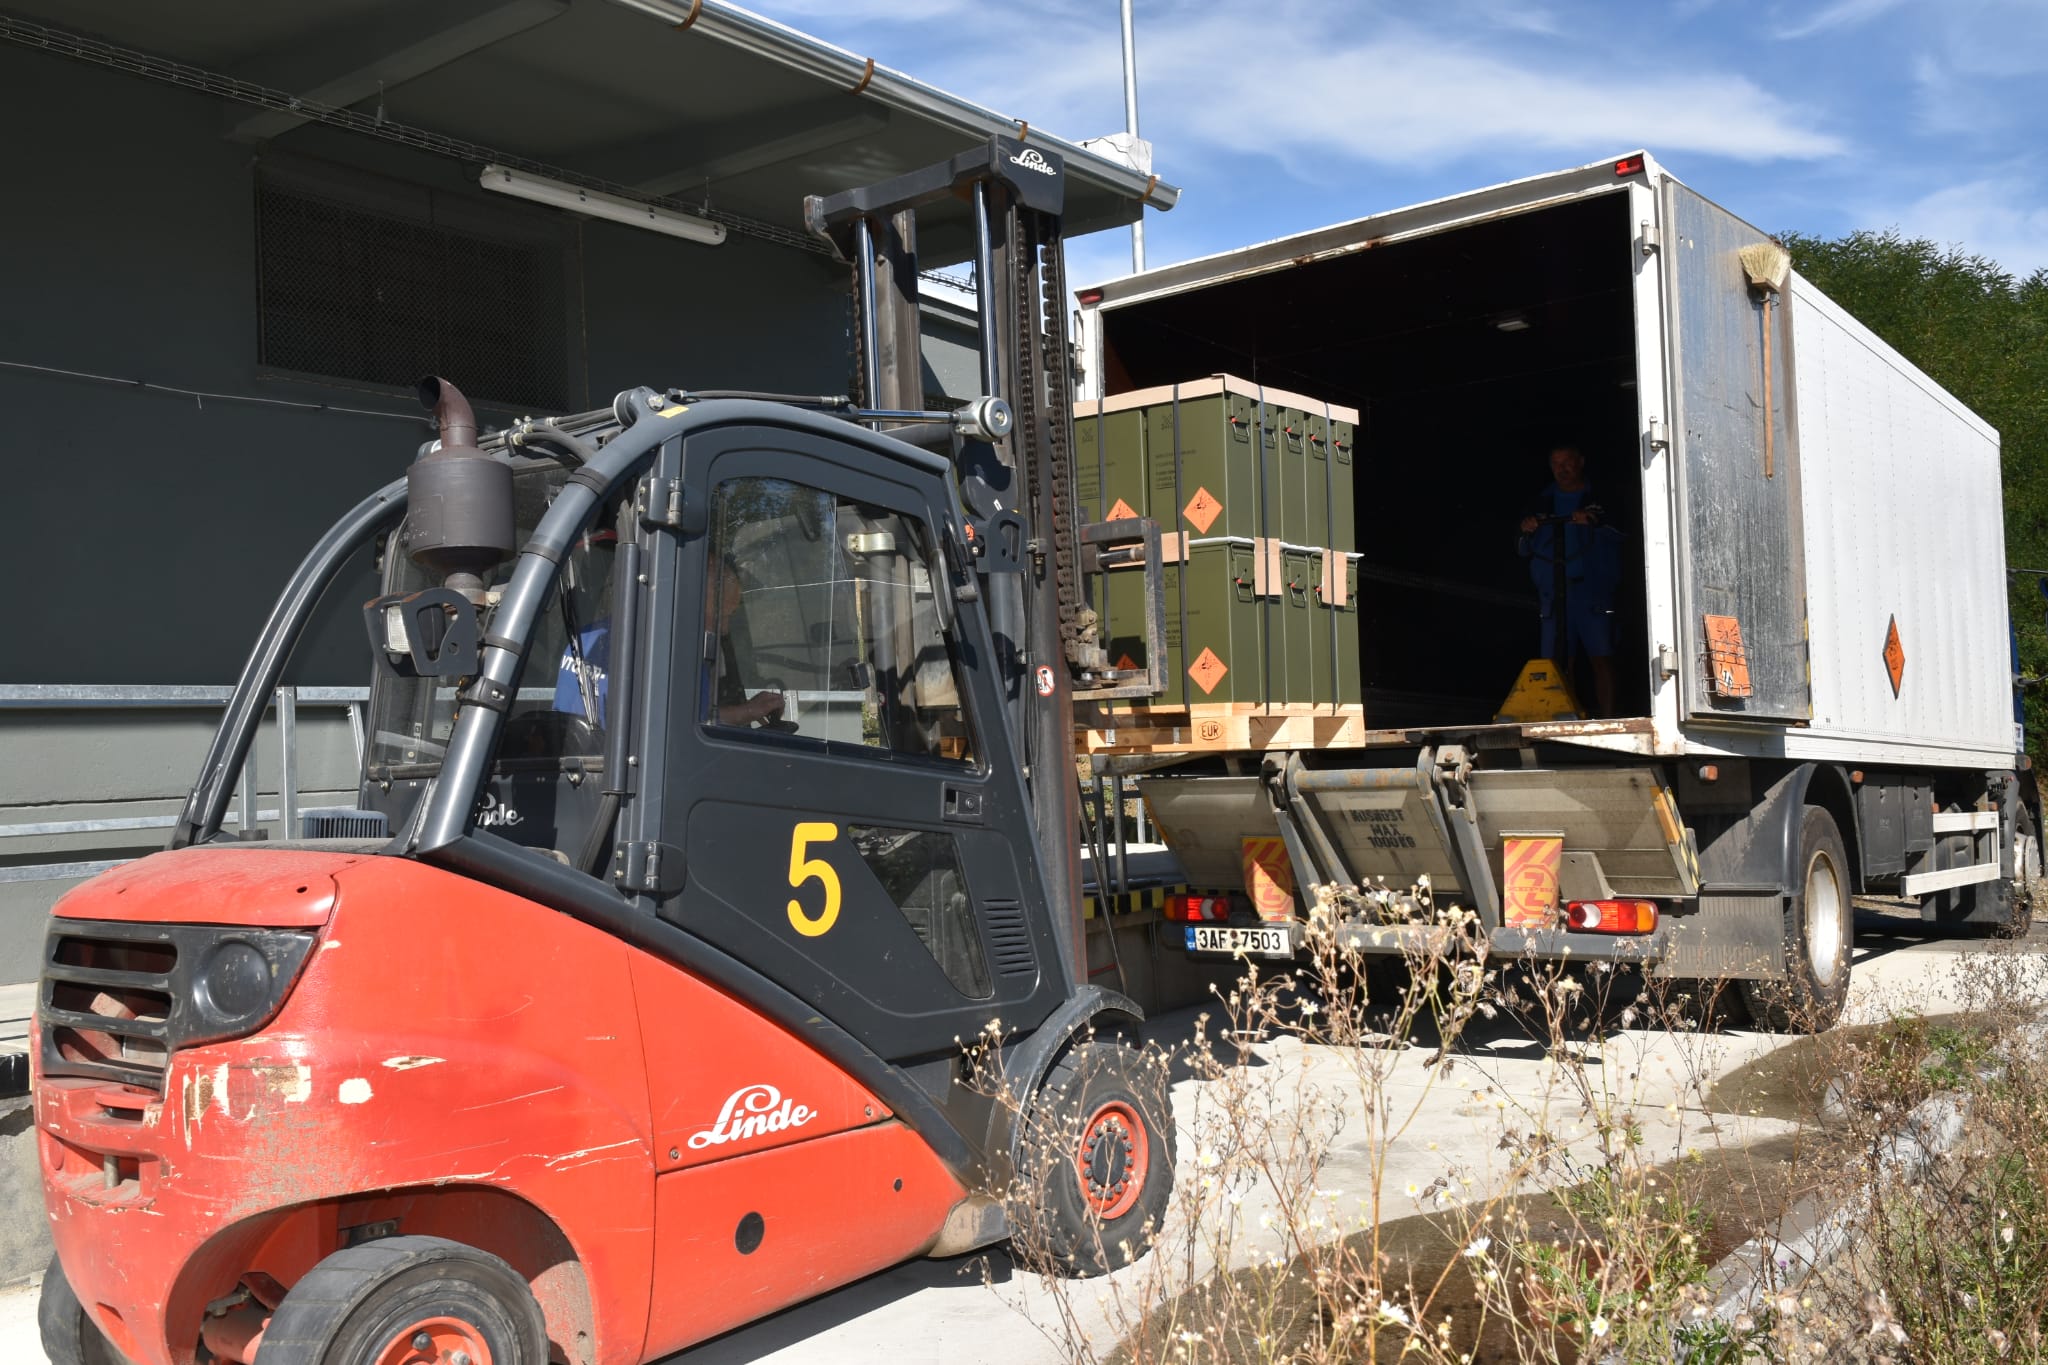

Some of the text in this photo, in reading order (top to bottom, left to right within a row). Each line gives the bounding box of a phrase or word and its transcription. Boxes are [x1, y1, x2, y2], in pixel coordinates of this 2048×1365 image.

[1010, 149, 1057, 175] Linde
[1201, 724, 1219, 738] EUR
[787, 822, 842, 937] 5
[1200, 930, 1281, 950] 3AF 7503
[687, 1084, 818, 1149] Linde
